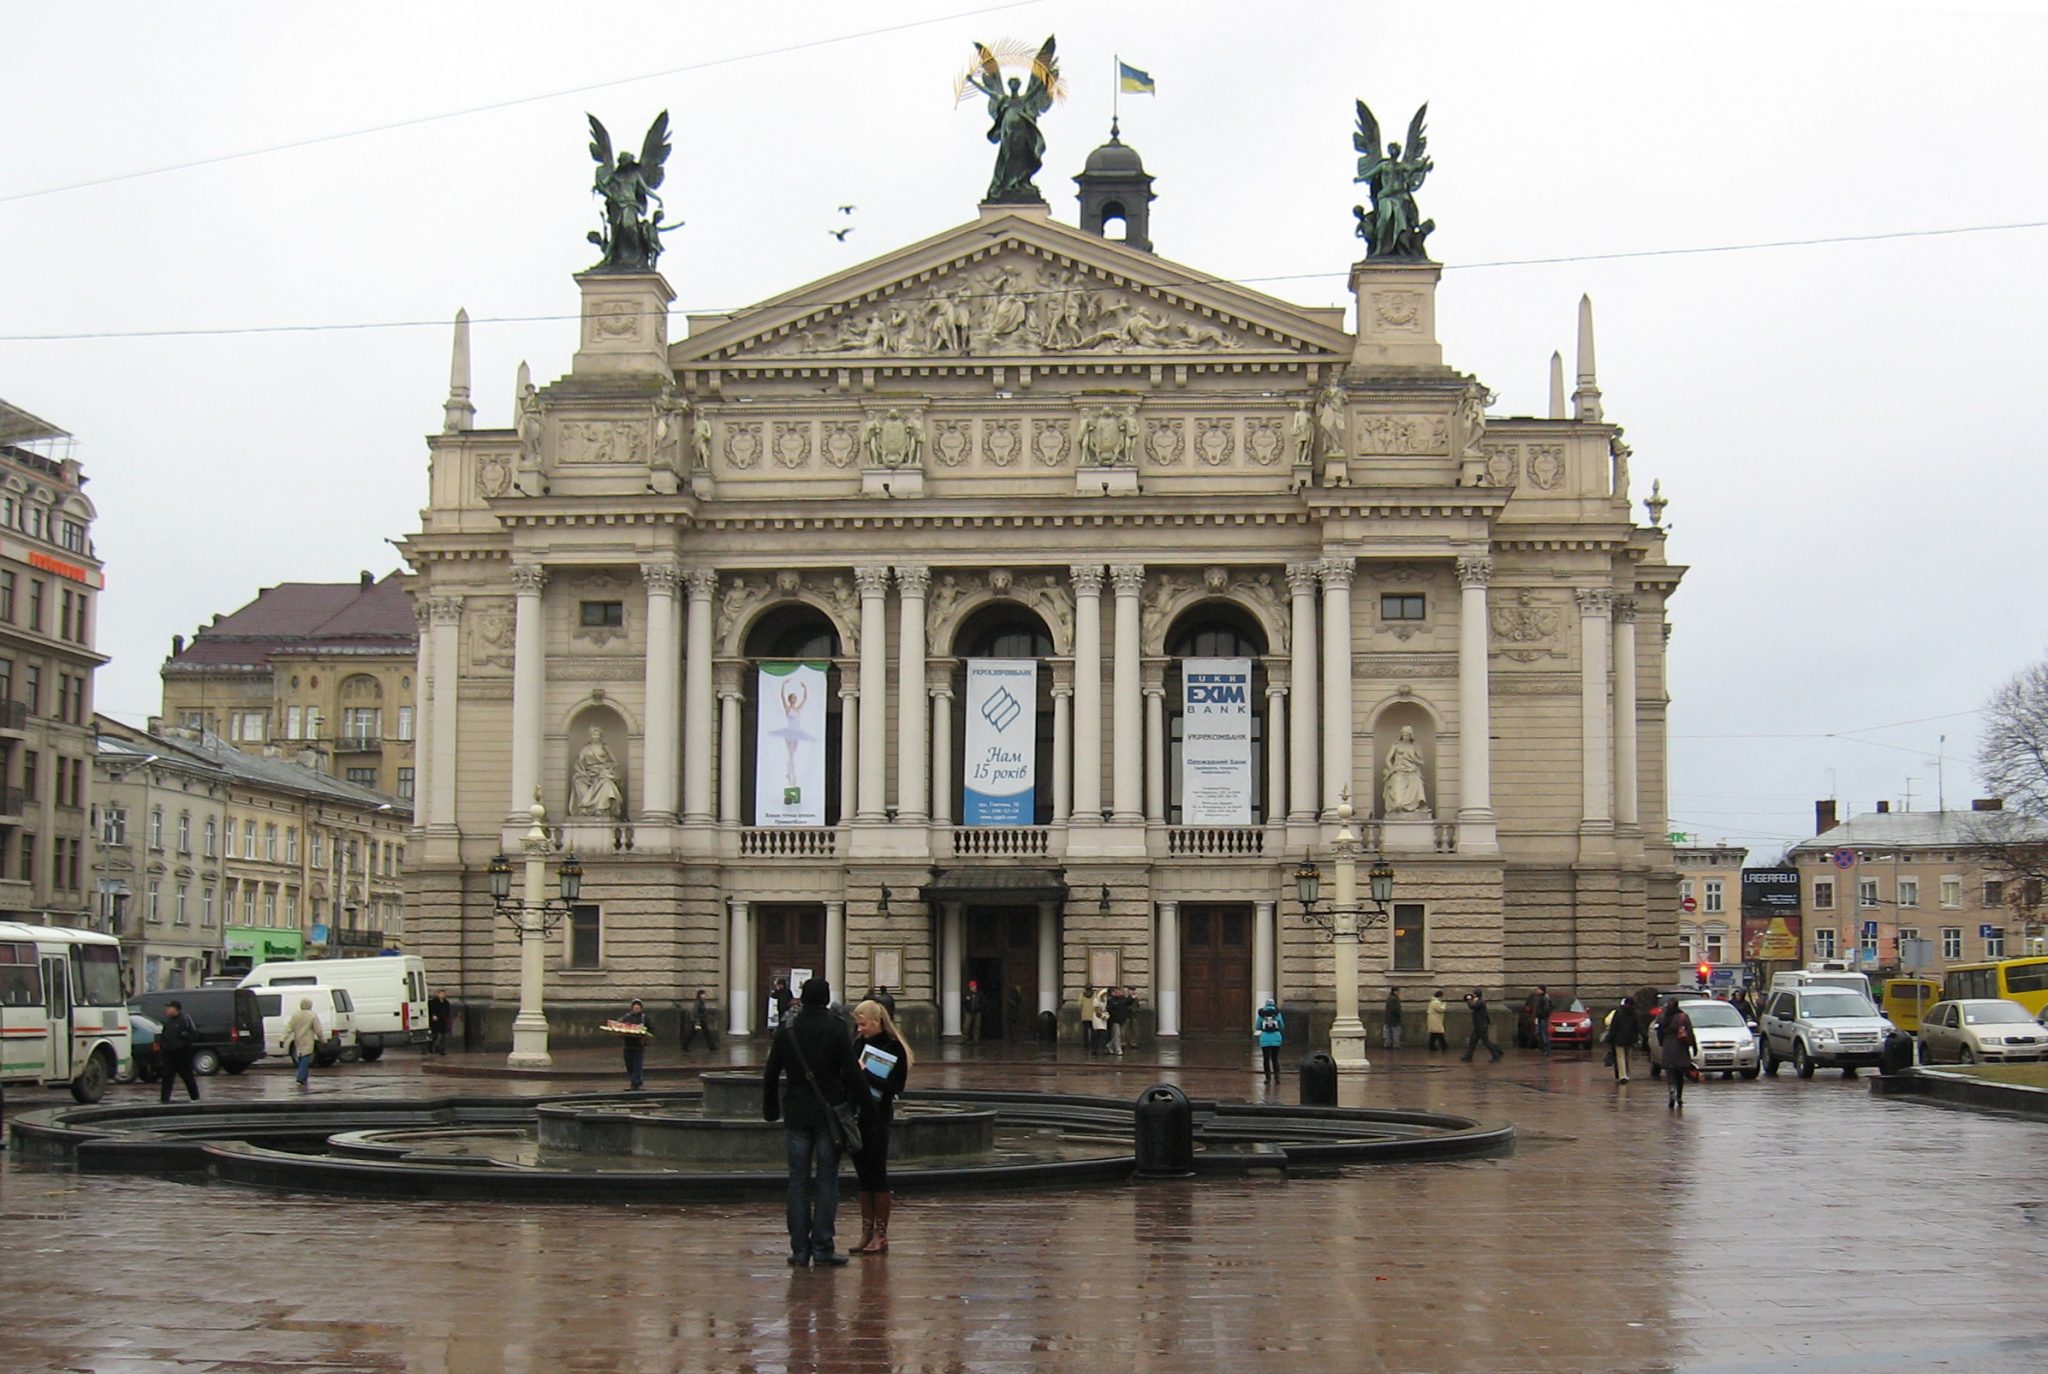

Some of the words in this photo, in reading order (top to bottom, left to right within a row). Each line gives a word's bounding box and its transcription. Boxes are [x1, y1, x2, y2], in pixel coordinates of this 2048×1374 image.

[1187, 686, 1246, 703] EXIM
[1187, 705, 1246, 714] BANK
[986, 746, 1022, 763] Нам
[973, 763, 990, 779] 15
[991, 765, 1028, 785] років
[1744, 873, 1797, 883] LAGERFELD
